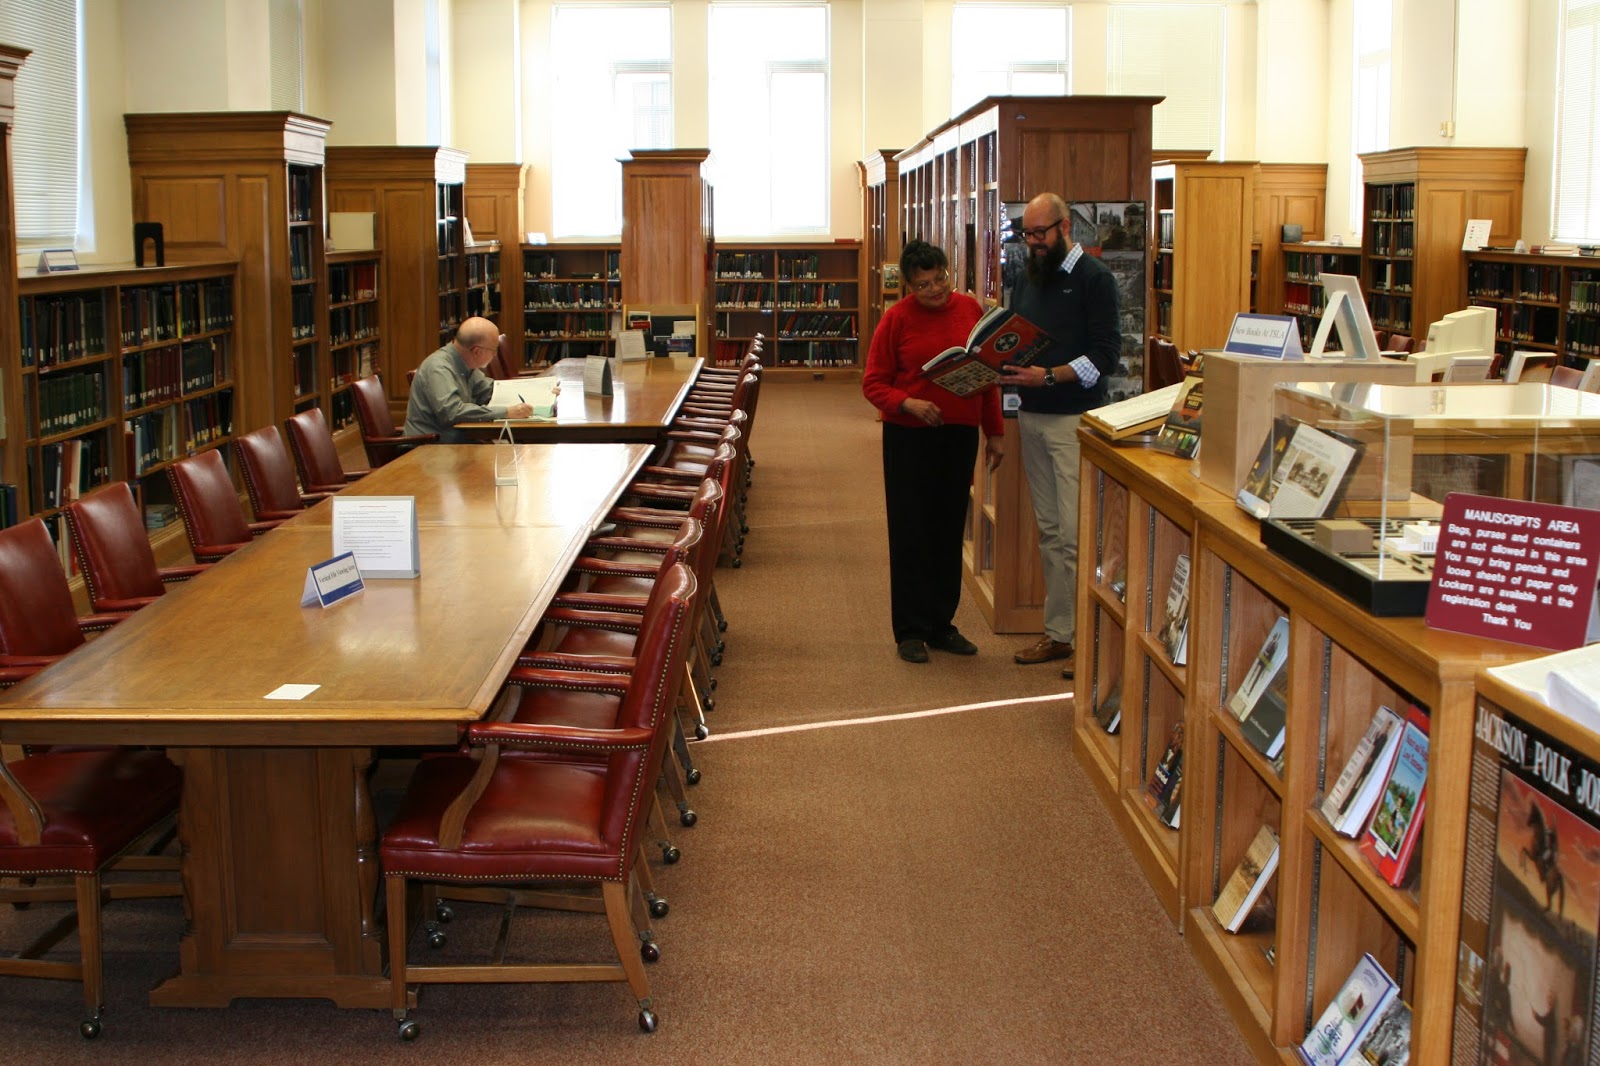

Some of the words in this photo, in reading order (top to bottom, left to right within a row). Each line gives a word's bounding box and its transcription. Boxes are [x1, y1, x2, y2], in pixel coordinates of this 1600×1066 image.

[1235, 325, 1245, 334] New
[1245, 326, 1261, 337] Books
[1465, 509, 1541, 528] MANUSCRIPTS
[1548, 520, 1580, 534] AREA
[1452, 540, 1466, 548] are
[1471, 542, 1486, 551] not
[1491, 544, 1525, 557] allowed
[1530, 549, 1539, 558] in
[1544, 551, 1561, 562] this
[1476, 529, 1506, 540] purses
[1511, 532, 1528, 542] and
[1533, 536, 1581, 550] containers
[1445, 551, 1461, 561] You
[1466, 555, 1484, 566] may
[1489, 558, 1510, 570] bring
[1515, 562, 1547, 575] pencils
[1552, 568, 1569, 577] and
[1447, 565, 1471, 577] loose
[1476, 570, 1505, 582] sheets
[1511, 576, 1521, 585] of
[1526, 579, 1553, 590] paper
[1558, 584, 1578, 595] only
[1439, 578, 1474, 592] Lockers
[1479, 586, 1494, 594] are
[1499, 588, 1537, 601] available
[1542, 596, 1552, 605] at
[1558, 597, 1573, 608] the
[1442, 594, 1490, 608] registration
[1495, 602, 1517, 612] desk
[1482, 613, 1508, 626] Thank
[1514, 619, 1532, 630] You
[1475, 706, 1528, 768] JACKSON
[1532, 740, 1572, 795] POLK
